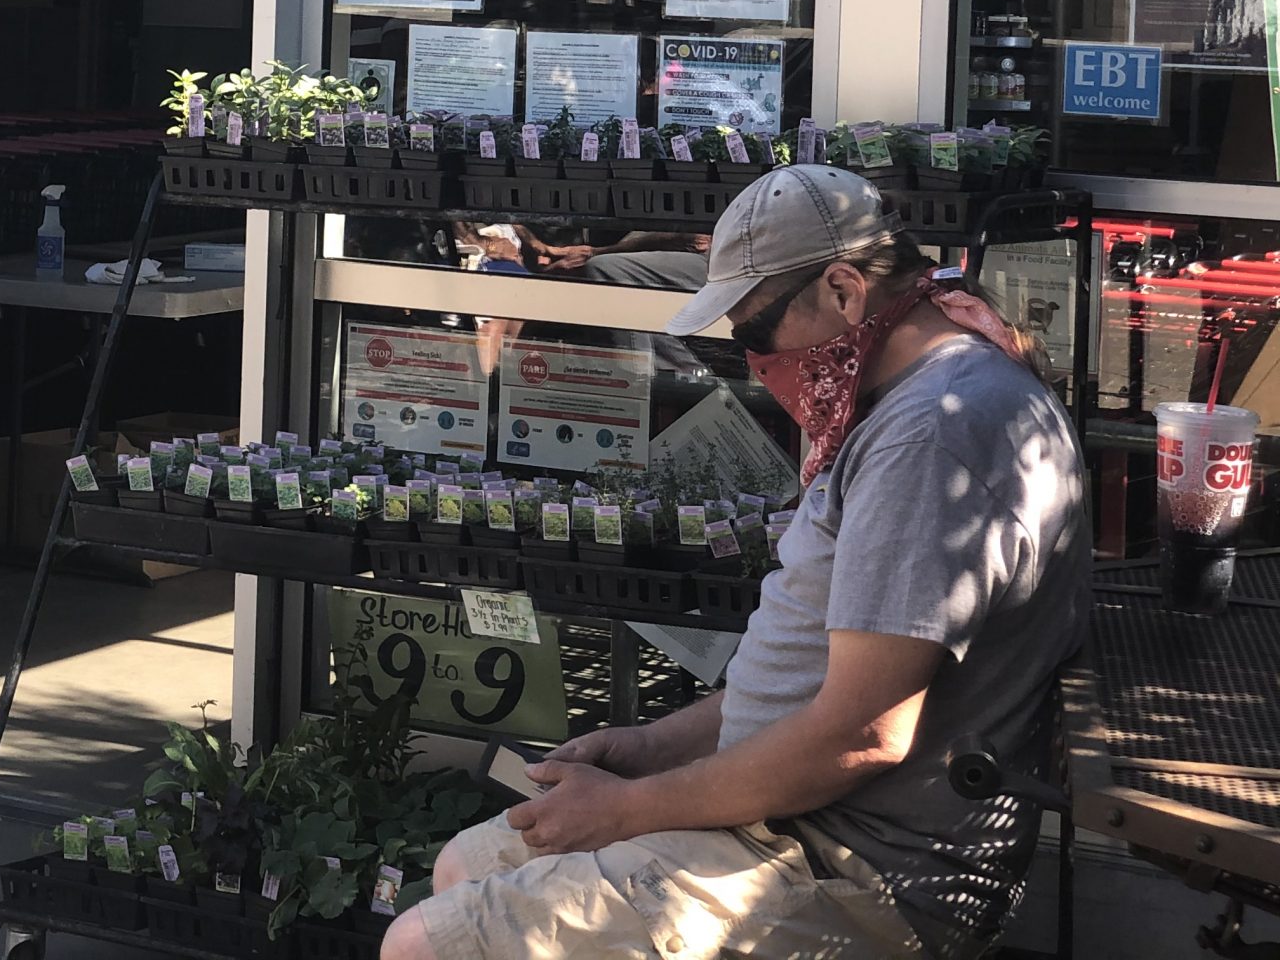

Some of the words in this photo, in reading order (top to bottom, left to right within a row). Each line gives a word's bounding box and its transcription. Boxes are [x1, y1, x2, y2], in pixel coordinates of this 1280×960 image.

[666, 43, 738, 60] COVID-19
[1074, 50, 1155, 89] EBT
[1073, 91, 1151, 110] welcome
[368, 349, 391, 359] STOP
[522, 365, 546, 375] PARE
[476, 595, 511, 614] Organic
[356, 597, 441, 634] Store
[501, 612, 529, 627] Plants
[350, 633, 426, 708] 9
[431, 654, 459, 681] to
[450, 646, 526, 726] 9
